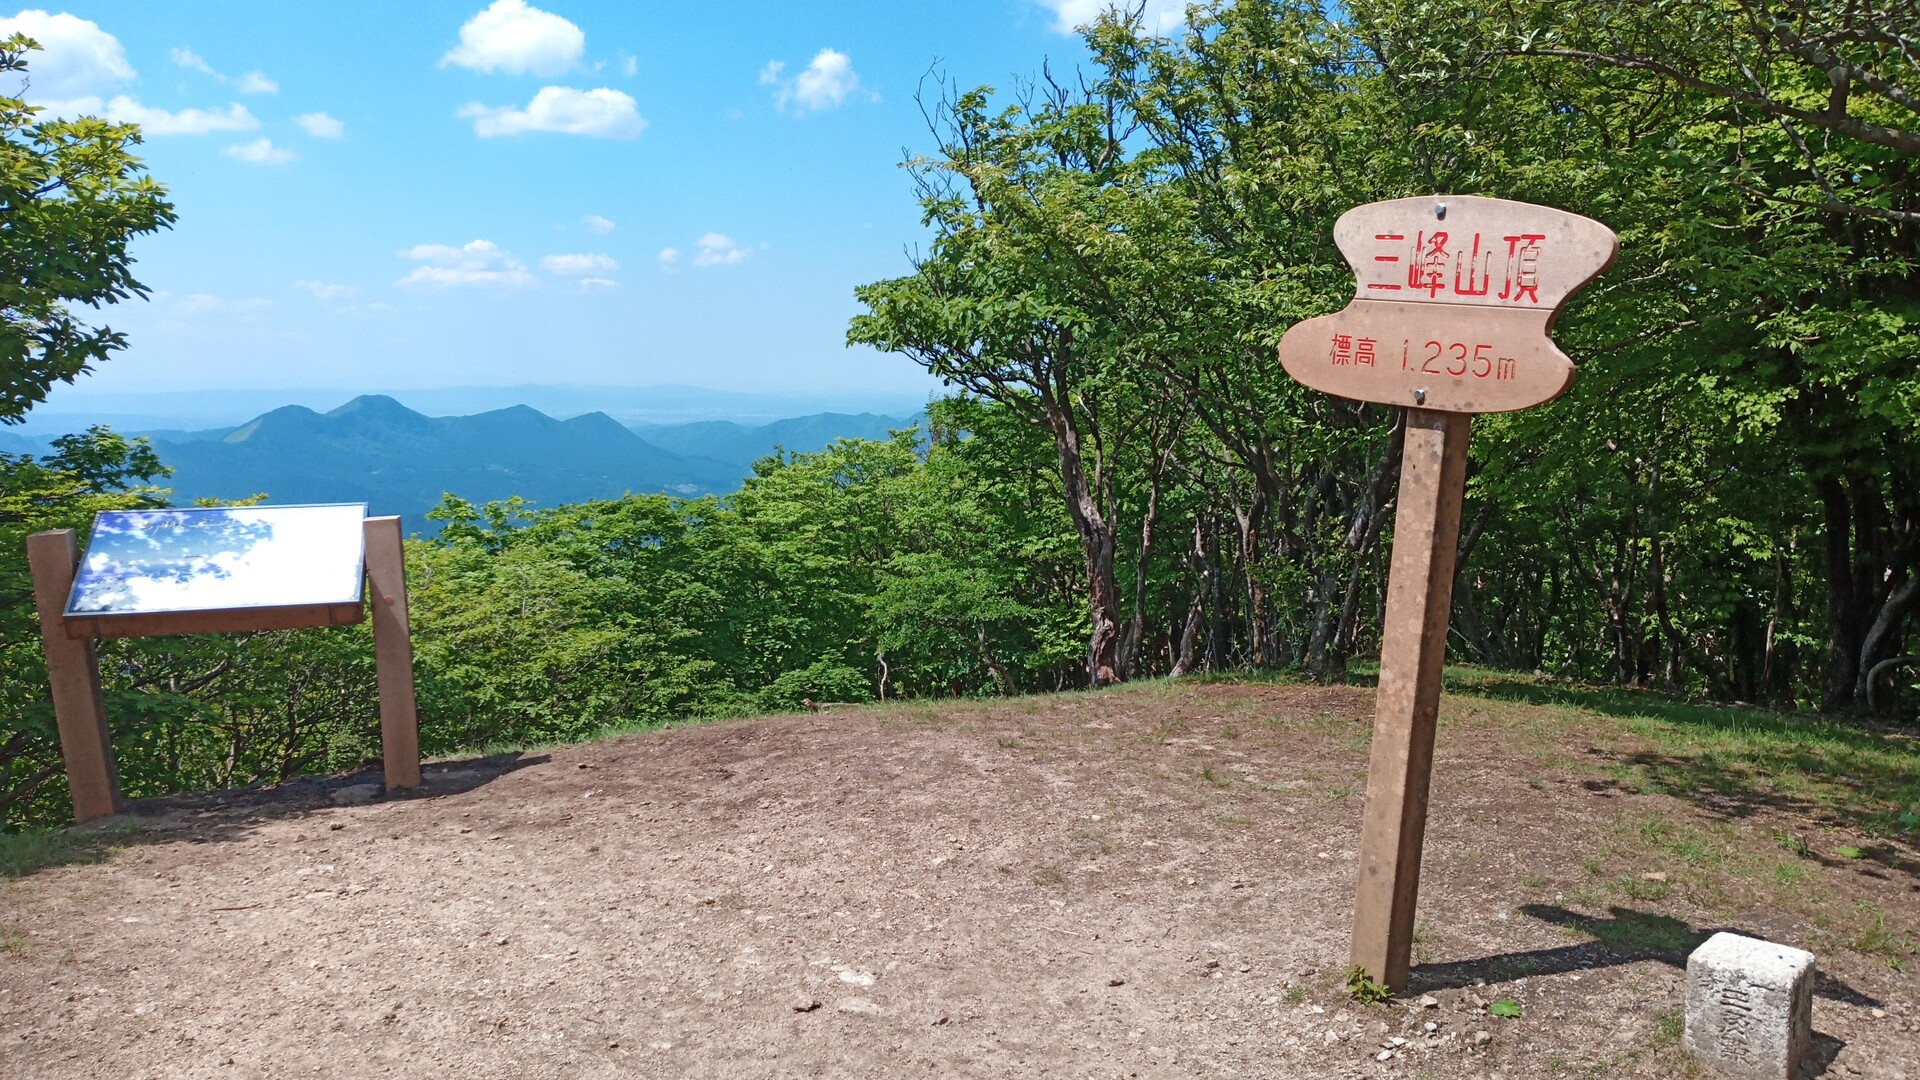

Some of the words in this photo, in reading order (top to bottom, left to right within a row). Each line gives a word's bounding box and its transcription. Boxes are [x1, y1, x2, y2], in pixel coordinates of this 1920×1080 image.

[1367, 230, 1546, 304] 三峰山頂
[1329, 333, 1377, 368] 標高
